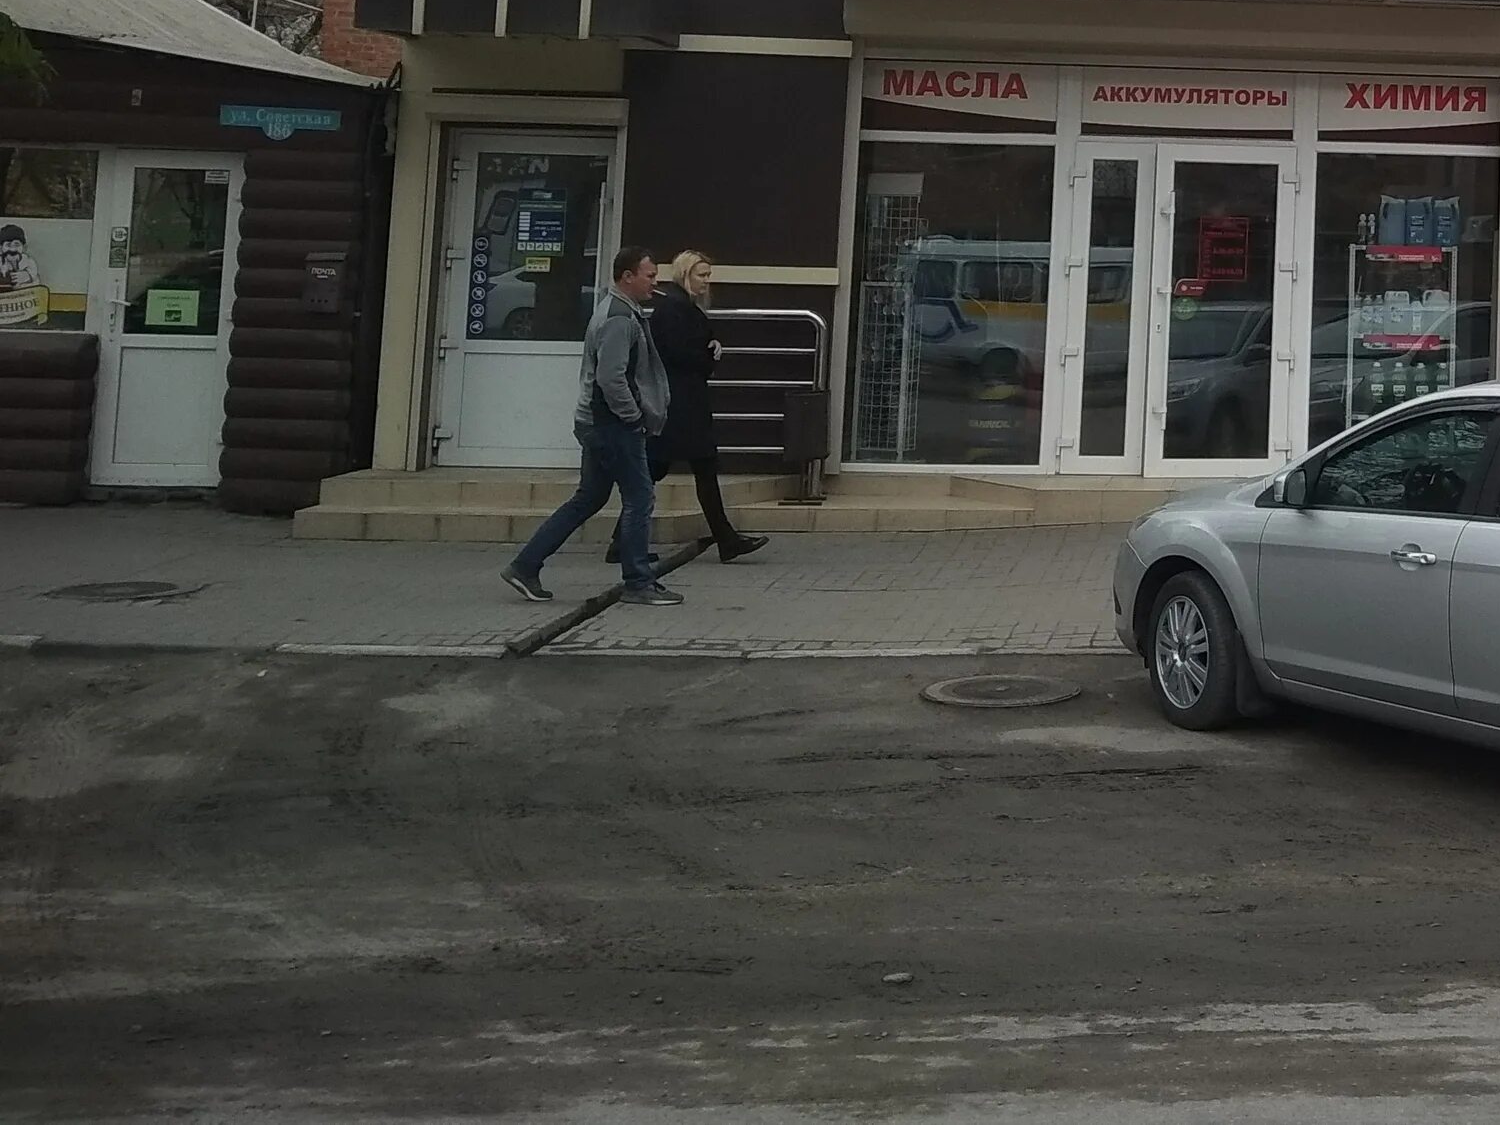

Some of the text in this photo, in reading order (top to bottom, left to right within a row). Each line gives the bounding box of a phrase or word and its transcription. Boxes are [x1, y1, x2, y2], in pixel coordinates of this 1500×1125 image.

[882, 69, 1029, 100] МАСЛА
[1092, 84, 1288, 107] АККУМУЛЯТОРЫ
[1343, 82, 1488, 113] ХИМИЯ
[230, 108, 331, 125] ул. Советская
[311, 267, 337, 275] ПОЧТА
